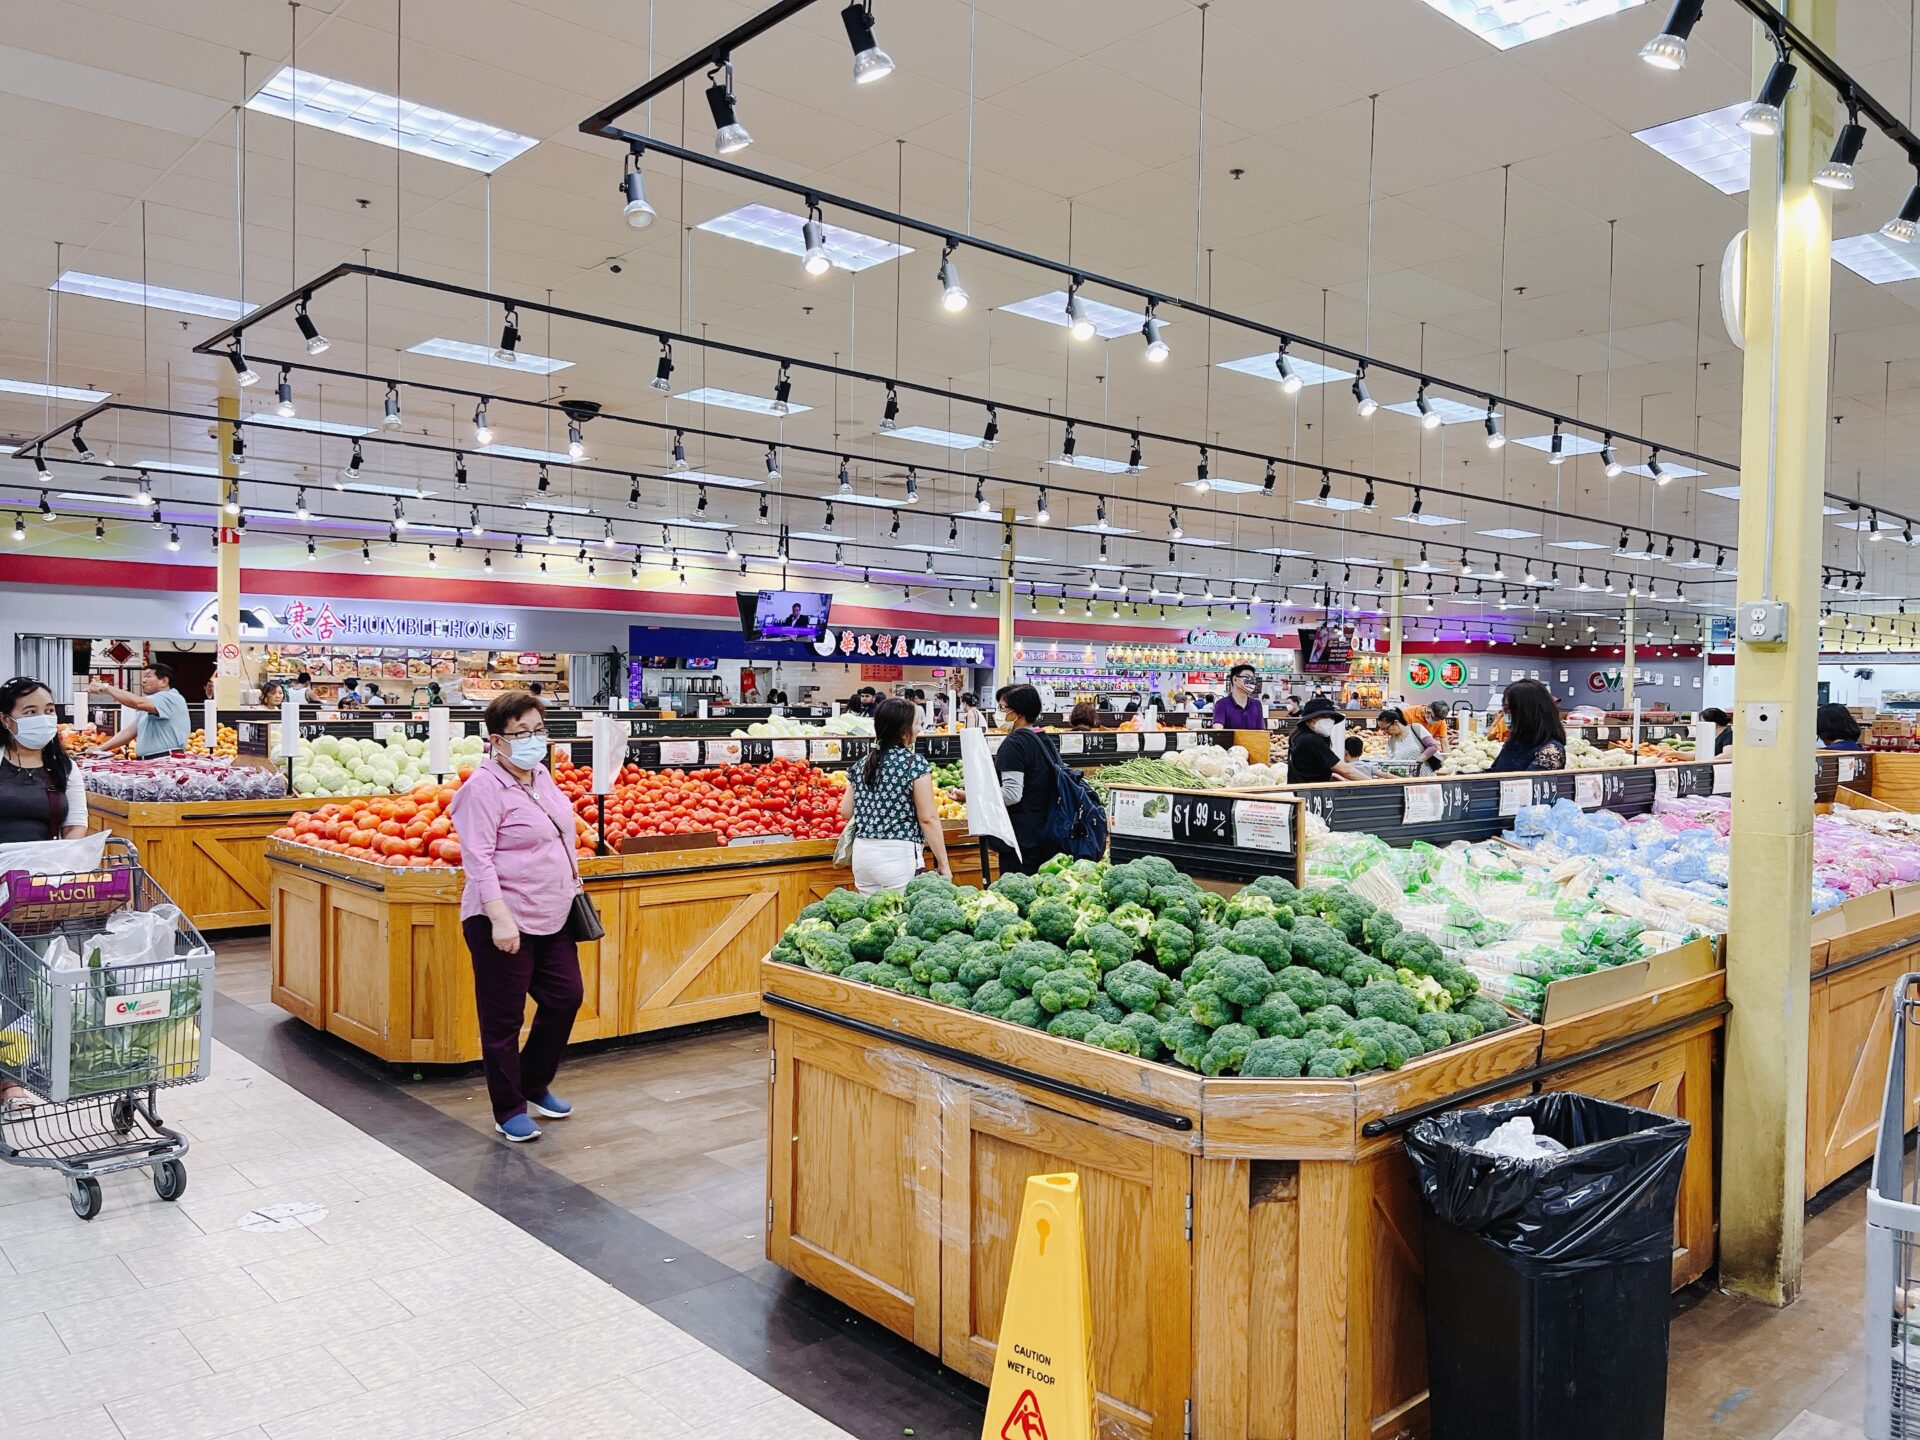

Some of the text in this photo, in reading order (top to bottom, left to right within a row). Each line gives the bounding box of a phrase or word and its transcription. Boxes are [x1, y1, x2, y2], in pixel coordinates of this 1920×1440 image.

[286, 601, 344, 639] 寒舍
[346, 615, 516, 640] HUMBLE HOUSE
[1190, 627, 1271, 648] Cantonese Cuisine
[912, 639, 984, 664] Mai Bakery
[116, 1000, 139, 1014] GW
[1014, 1344, 1051, 1366] CAUTION
[1007, 1359, 1056, 1386] WET FLOOR
